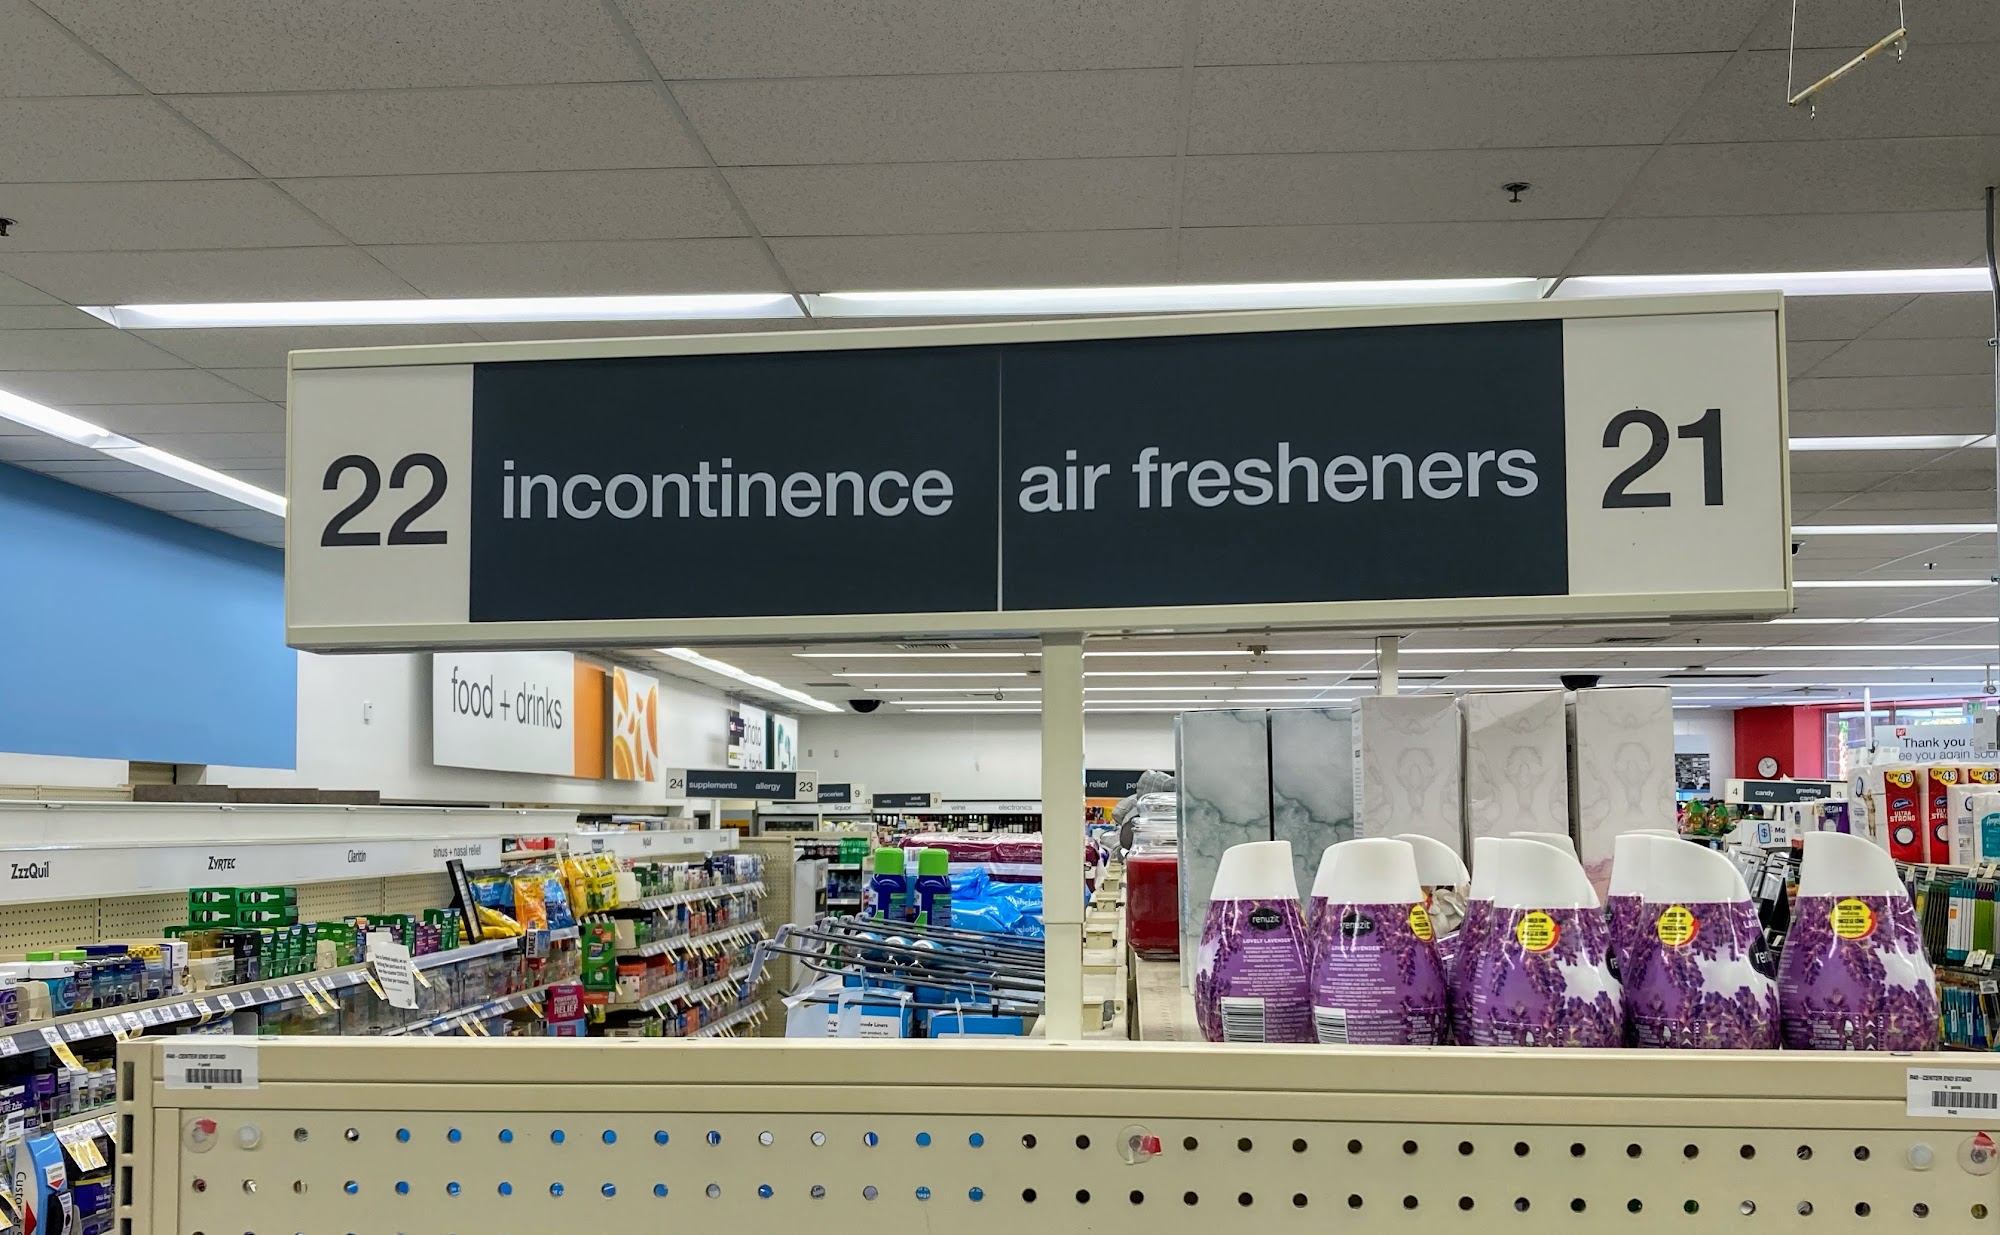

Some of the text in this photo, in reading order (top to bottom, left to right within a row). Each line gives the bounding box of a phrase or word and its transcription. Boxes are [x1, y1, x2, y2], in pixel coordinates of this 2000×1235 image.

[1601, 408, 1724, 509] 21
[1018, 441, 1539, 513] air fresheners
[503, 460, 953, 519] incontinence
[321, 453, 448, 547] 22
[452, 666, 562, 730] food + drinks
[1903, 738, 1940, 748] Thank
[1943, 739, 1966, 749] you
[1915, 752, 1936, 762] you
[1940, 751, 1970, 760] again
[1898, 773, 1912, 782] 48
[1942, 770, 1956, 780] 48
[1982, 771, 1996, 780] 48
[669, 778, 683, 789] 24
[688, 780, 781, 792] supplements allergy
[799, 781, 813, 792] 23
[1089, 780, 1109, 788] relief
[818, 791, 844, 799] groceries
[855, 790, 860, 798] 9
[1732, 787, 1738, 796] 4
[1795, 788, 1821, 796] greeting
[347, 849, 367, 863] Claritin
[433, 845, 448, 858] sinus
[453, 845, 468, 857] nasal
[468, 844, 482, 856] relief
[208, 856, 236, 871] ZYRTEC
[11, 861, 50, 879] ZzzQuil
[1252, 914, 1280, 923] renuzit
[554, 1004, 578, 1015] RELIEF
